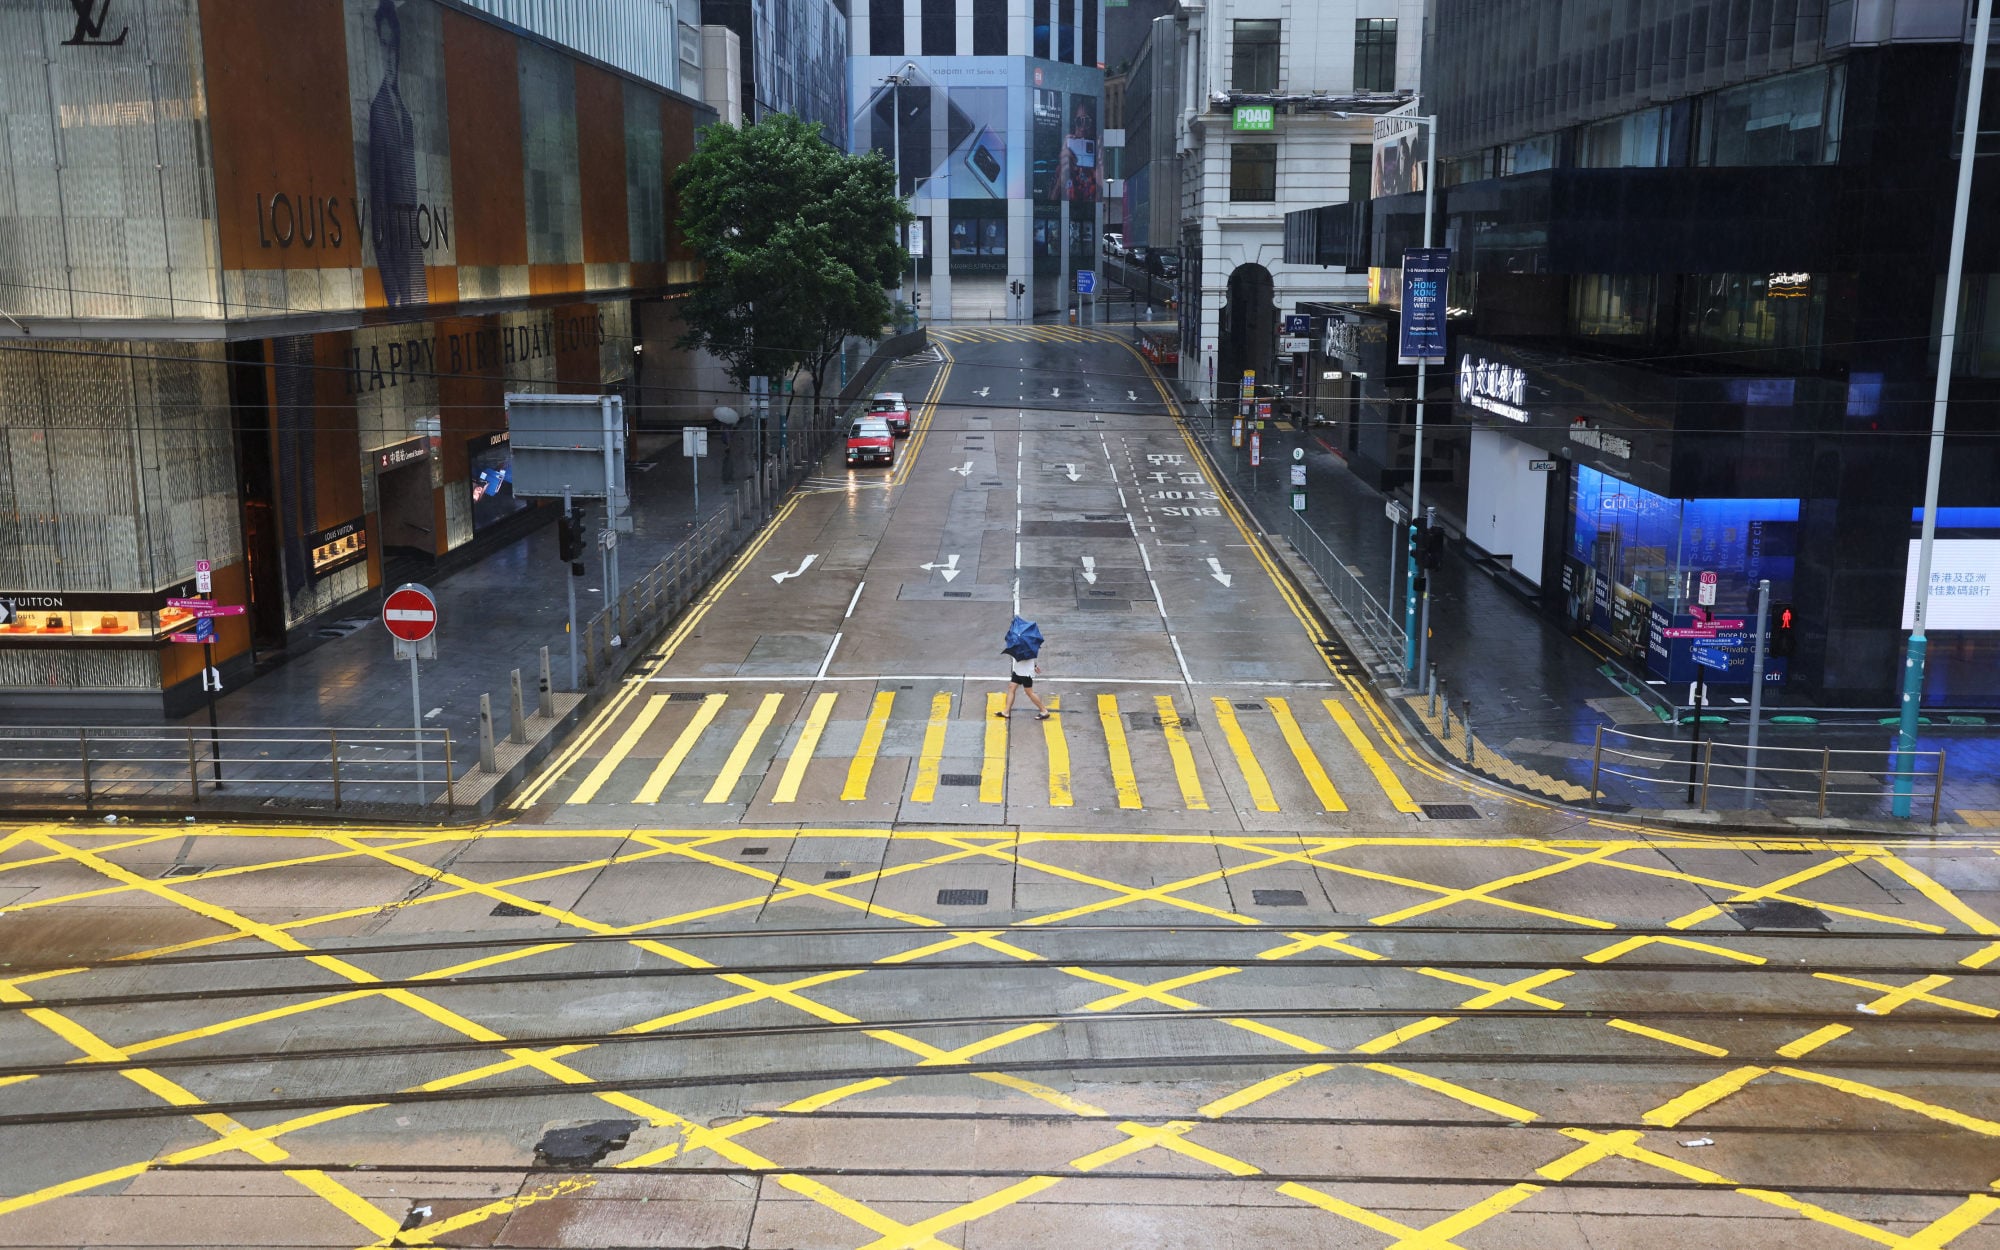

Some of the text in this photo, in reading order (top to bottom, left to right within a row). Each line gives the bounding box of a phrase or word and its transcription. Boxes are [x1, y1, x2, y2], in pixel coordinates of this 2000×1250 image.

[1237, 109, 1270, 122] POAD
[1374, 117, 1390, 141] FEELS
[256, 191, 449, 253] LOUIS VUITTON
[1413, 281, 1437, 289] HONG
[1413, 289, 1437, 297] KONG
[345, 312, 606, 395] HAPPY BIRTHDAY LOUIS
[1149, 490, 1220, 500] STOP
[1161, 506, 1221, 517] BUS
[325, 524, 354, 541] LOUIS VUITTON
[1751, 538, 1760, 567] more
[1931, 572, 1987, 582] 香港及亞洲
[1718, 631, 1738, 639] more
[1739, 630, 1748, 639] to
[1721, 645, 1748, 654] Private
[1765, 671, 1782, 681] citi
